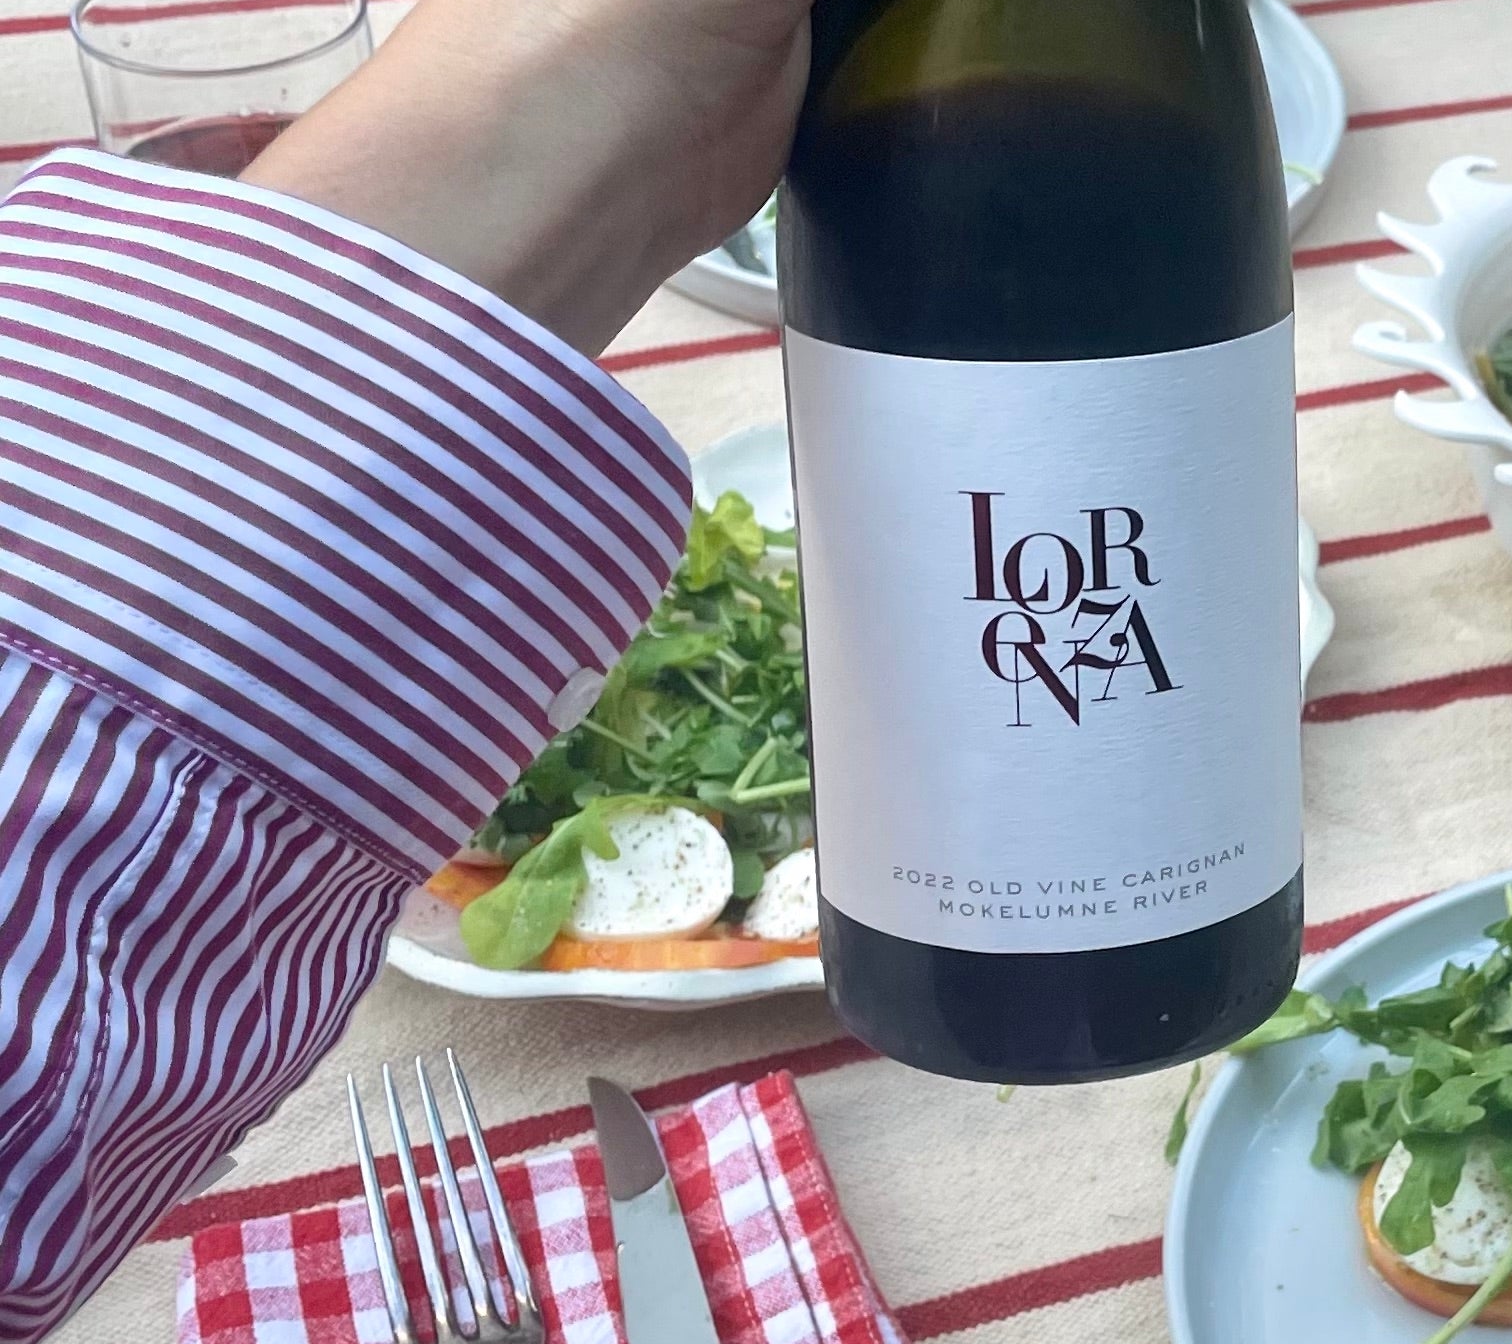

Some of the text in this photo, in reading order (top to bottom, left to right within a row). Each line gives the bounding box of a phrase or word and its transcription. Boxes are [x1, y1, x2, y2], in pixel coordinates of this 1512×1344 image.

[892, 841, 1246, 896] 2022 OLD VINE CARIGNAN
[938, 879, 1209, 920] MOKELUMNE RIVER
